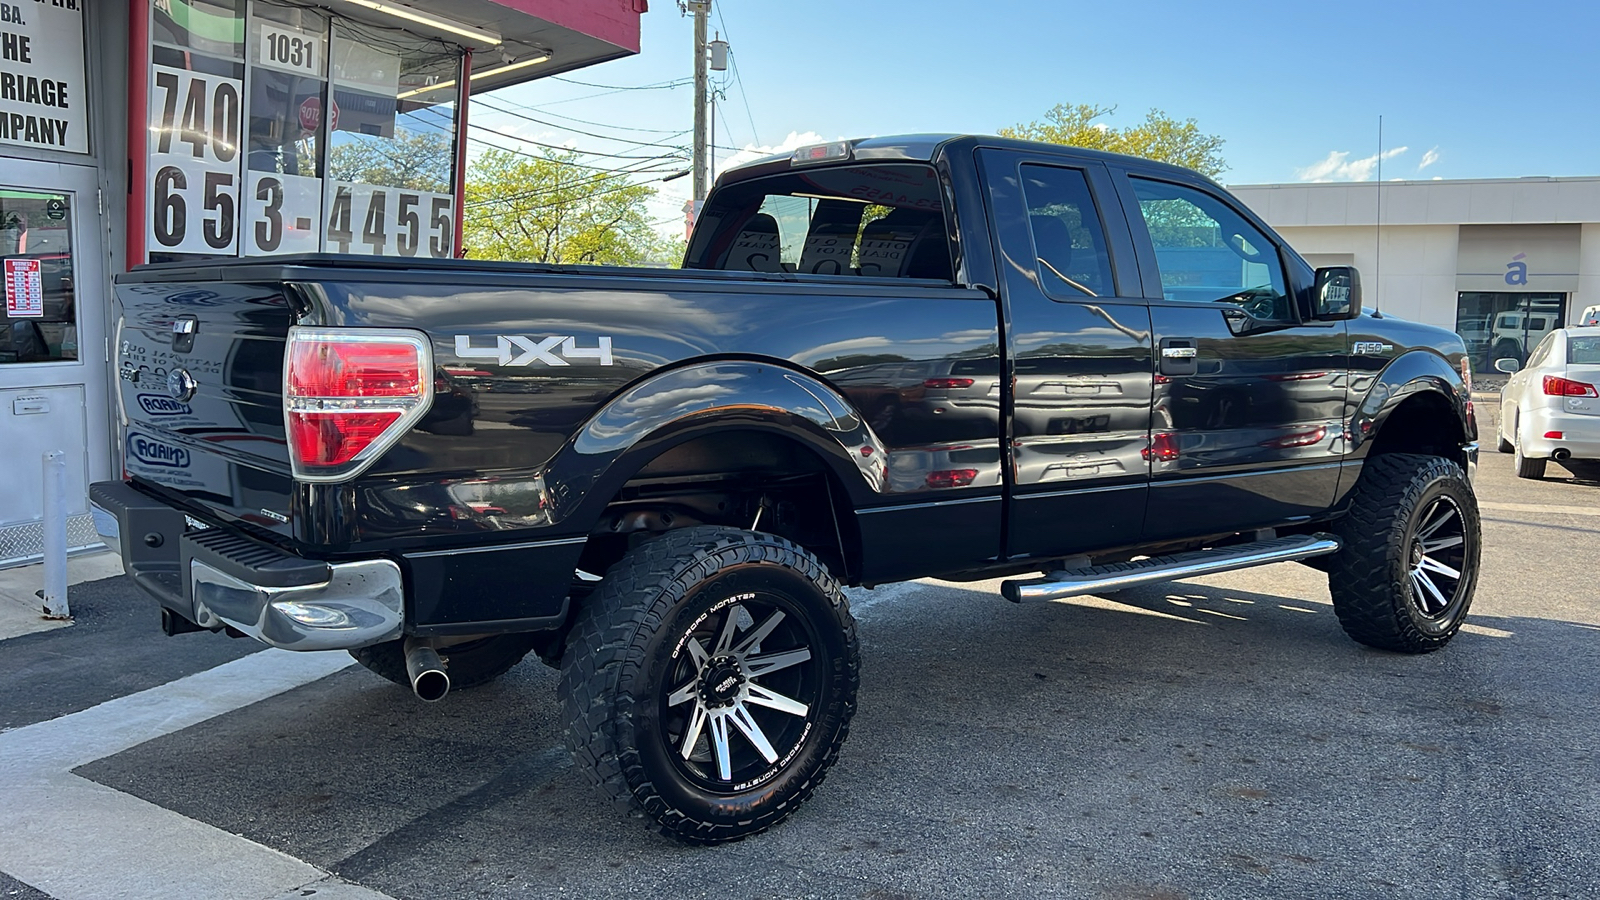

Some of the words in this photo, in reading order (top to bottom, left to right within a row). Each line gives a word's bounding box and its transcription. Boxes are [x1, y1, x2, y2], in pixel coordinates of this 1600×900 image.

[0, 31, 31, 64] HE
[267, 32, 313, 69] 1031
[1, 72, 69, 109] RIAGE
[156, 71, 239, 163] 740
[710, 593, 755, 613] MONSTER
